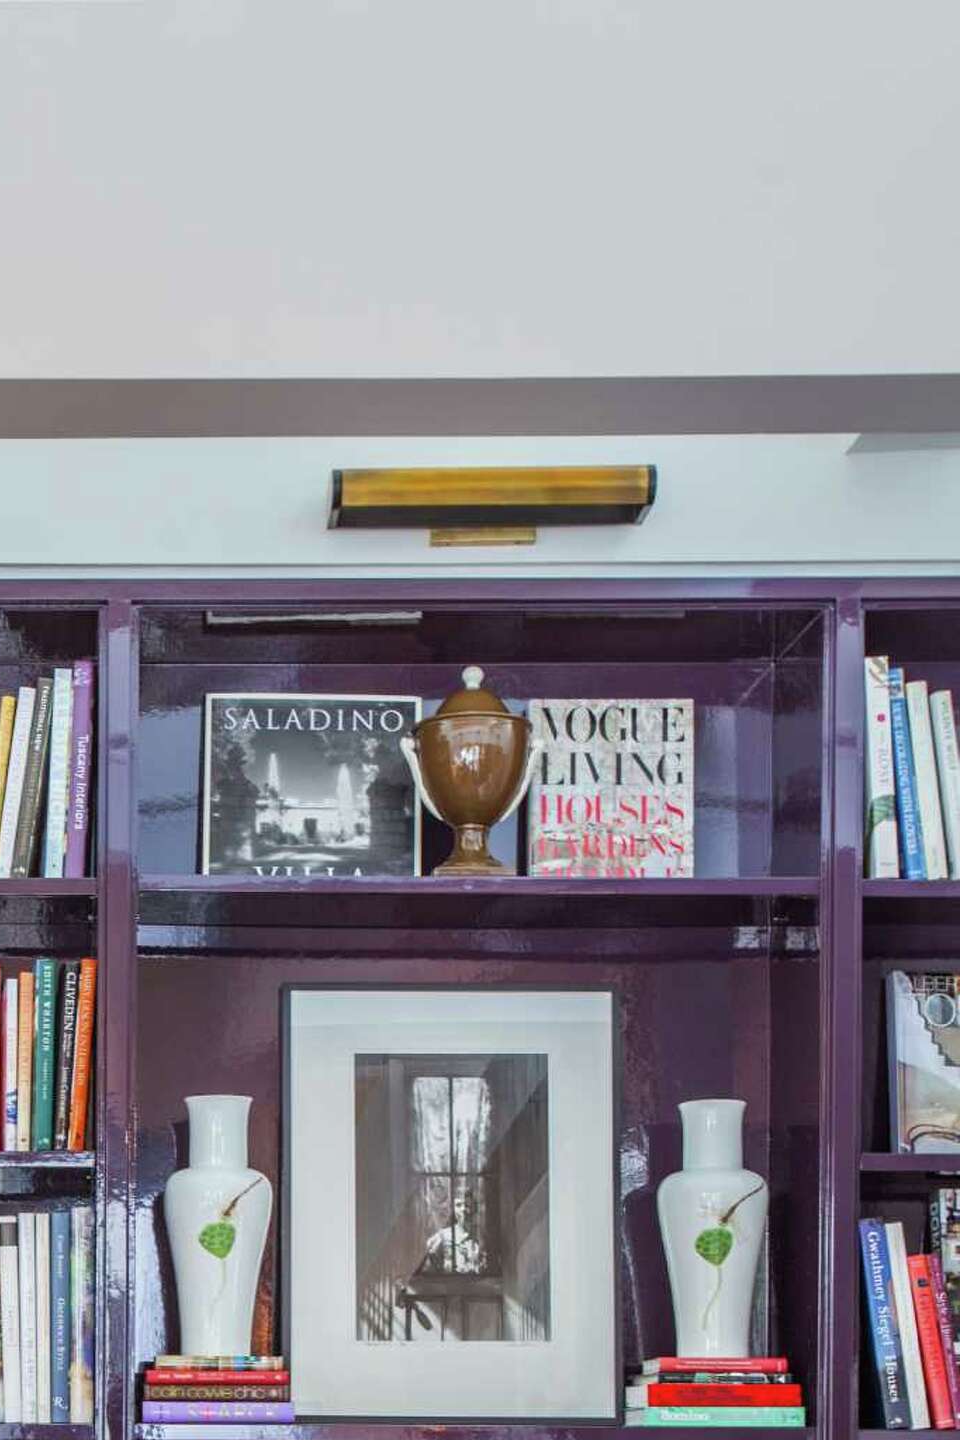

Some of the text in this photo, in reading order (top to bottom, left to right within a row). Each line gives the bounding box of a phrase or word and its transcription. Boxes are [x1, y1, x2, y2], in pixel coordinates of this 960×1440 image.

[224, 708, 404, 732] SALADINO
[539, 707, 685, 742] VOGUE
[74, 734, 89, 830] Tuscany Interiors
[539, 752, 684, 786] LIVING
[539, 794, 685, 826] HOUSES
[63, 972, 77, 1031] CLIVEDEN
[42, 1001, 52, 1052] WHARTON
[866, 1231, 902, 1403] Gwathmey Siegel Houses
